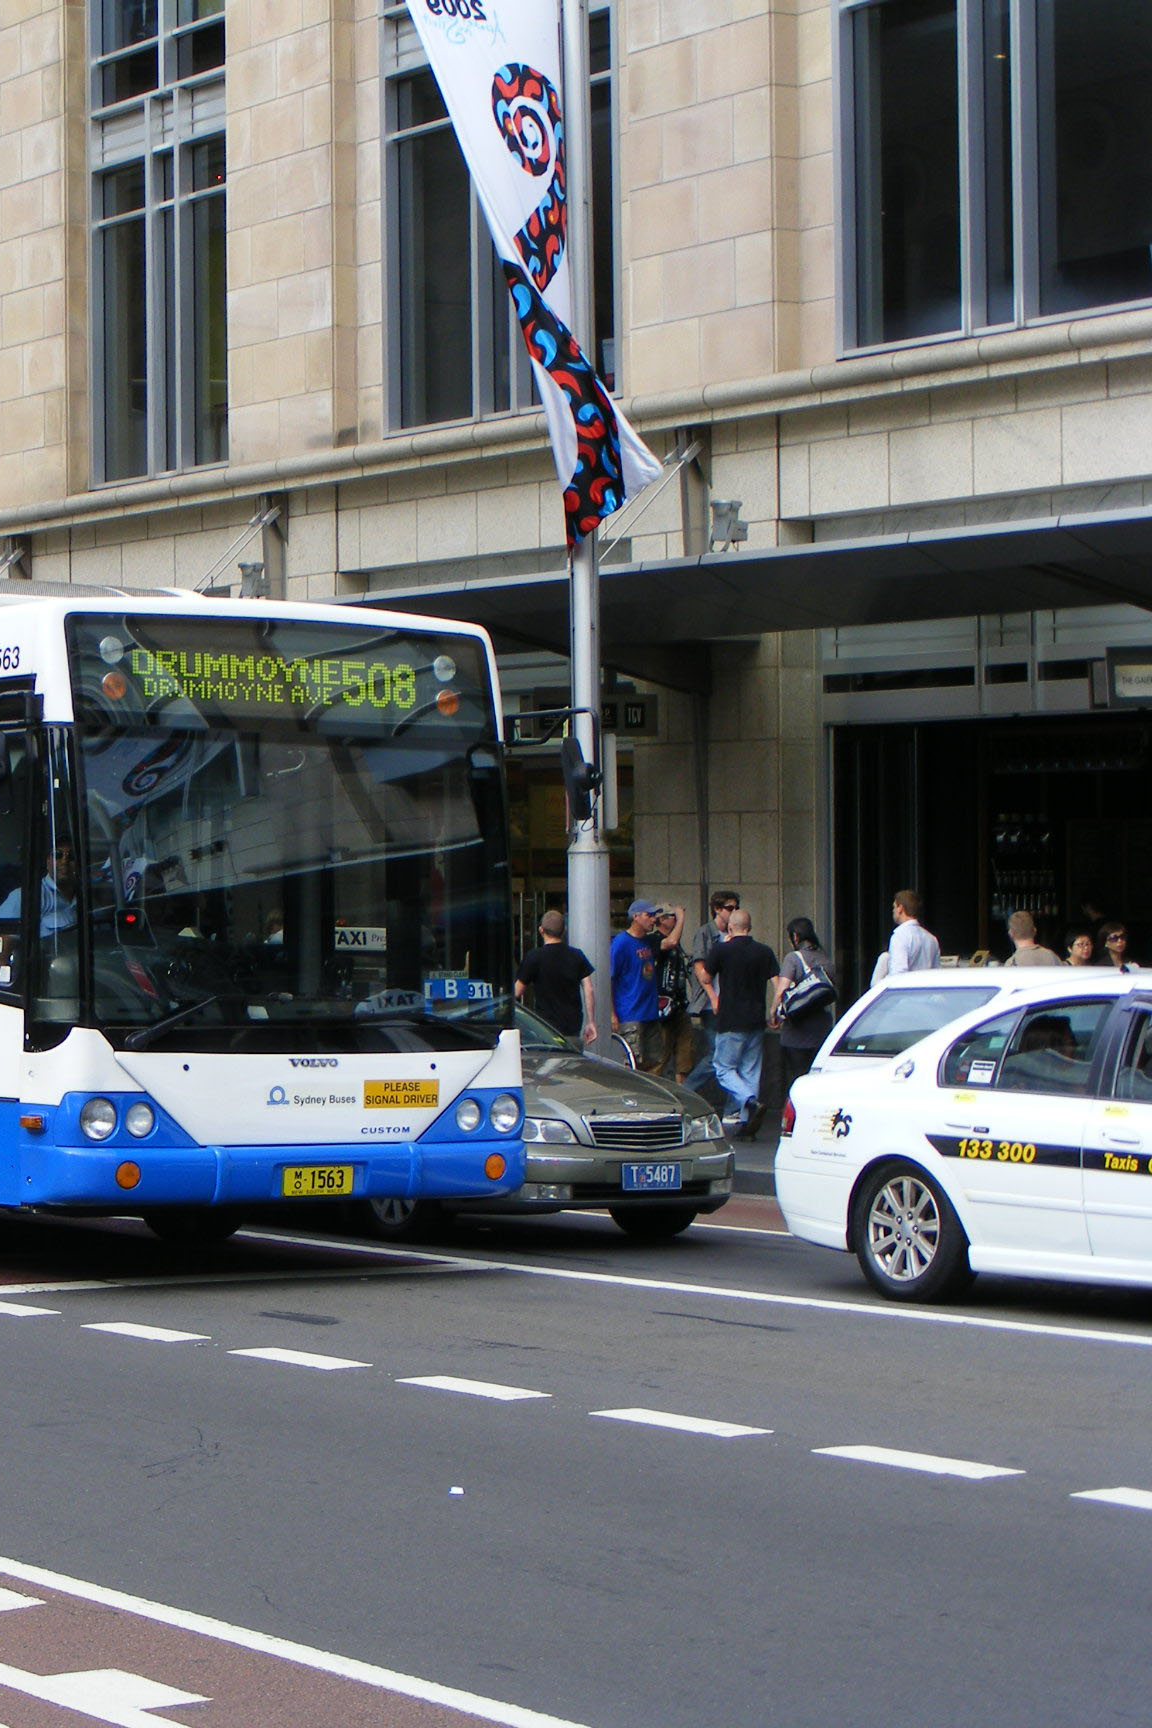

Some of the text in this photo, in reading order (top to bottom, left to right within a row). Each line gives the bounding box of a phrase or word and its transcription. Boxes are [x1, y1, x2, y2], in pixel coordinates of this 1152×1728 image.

[132, 649, 416, 709] DRUMMOYNE 508
[144, 677, 333, 705] DRUMMOYNE AVE
[288, 1058, 338, 1068] VOLVO
[384, 1082, 420, 1092] PLEASE
[293, 1094, 356, 1107] Sydney Buses
[365, 1094, 438, 1105] SIGNAL DRIVER
[361, 1126, 410, 1134] CUSTOM
[958, 1138, 1036, 1164] 133 300
[1104, 1152, 1138, 1172] Taxis
